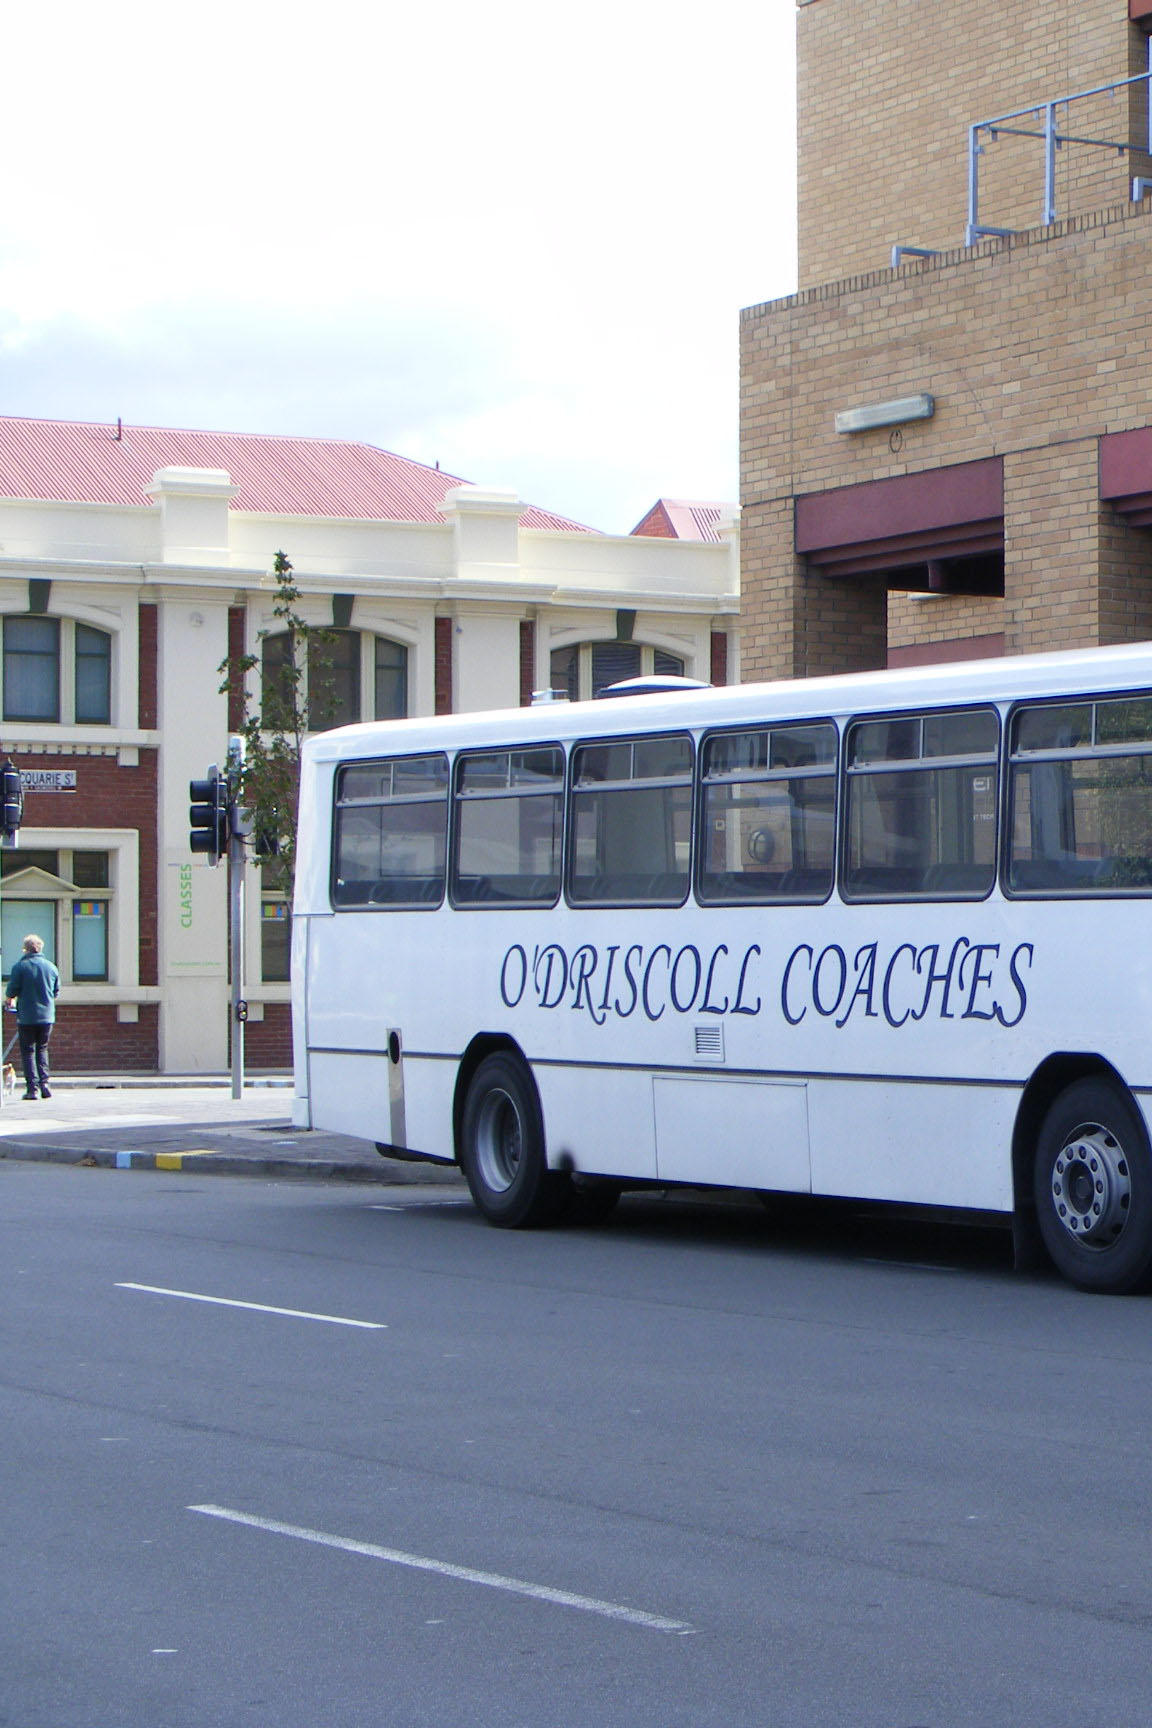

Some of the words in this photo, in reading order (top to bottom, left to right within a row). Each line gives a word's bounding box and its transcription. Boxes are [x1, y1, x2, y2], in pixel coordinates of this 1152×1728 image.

[180, 863, 192, 928] CLASSES
[500, 943, 761, 1026] O'DRISCOLL
[782, 937, 1034, 1028] COACHES
